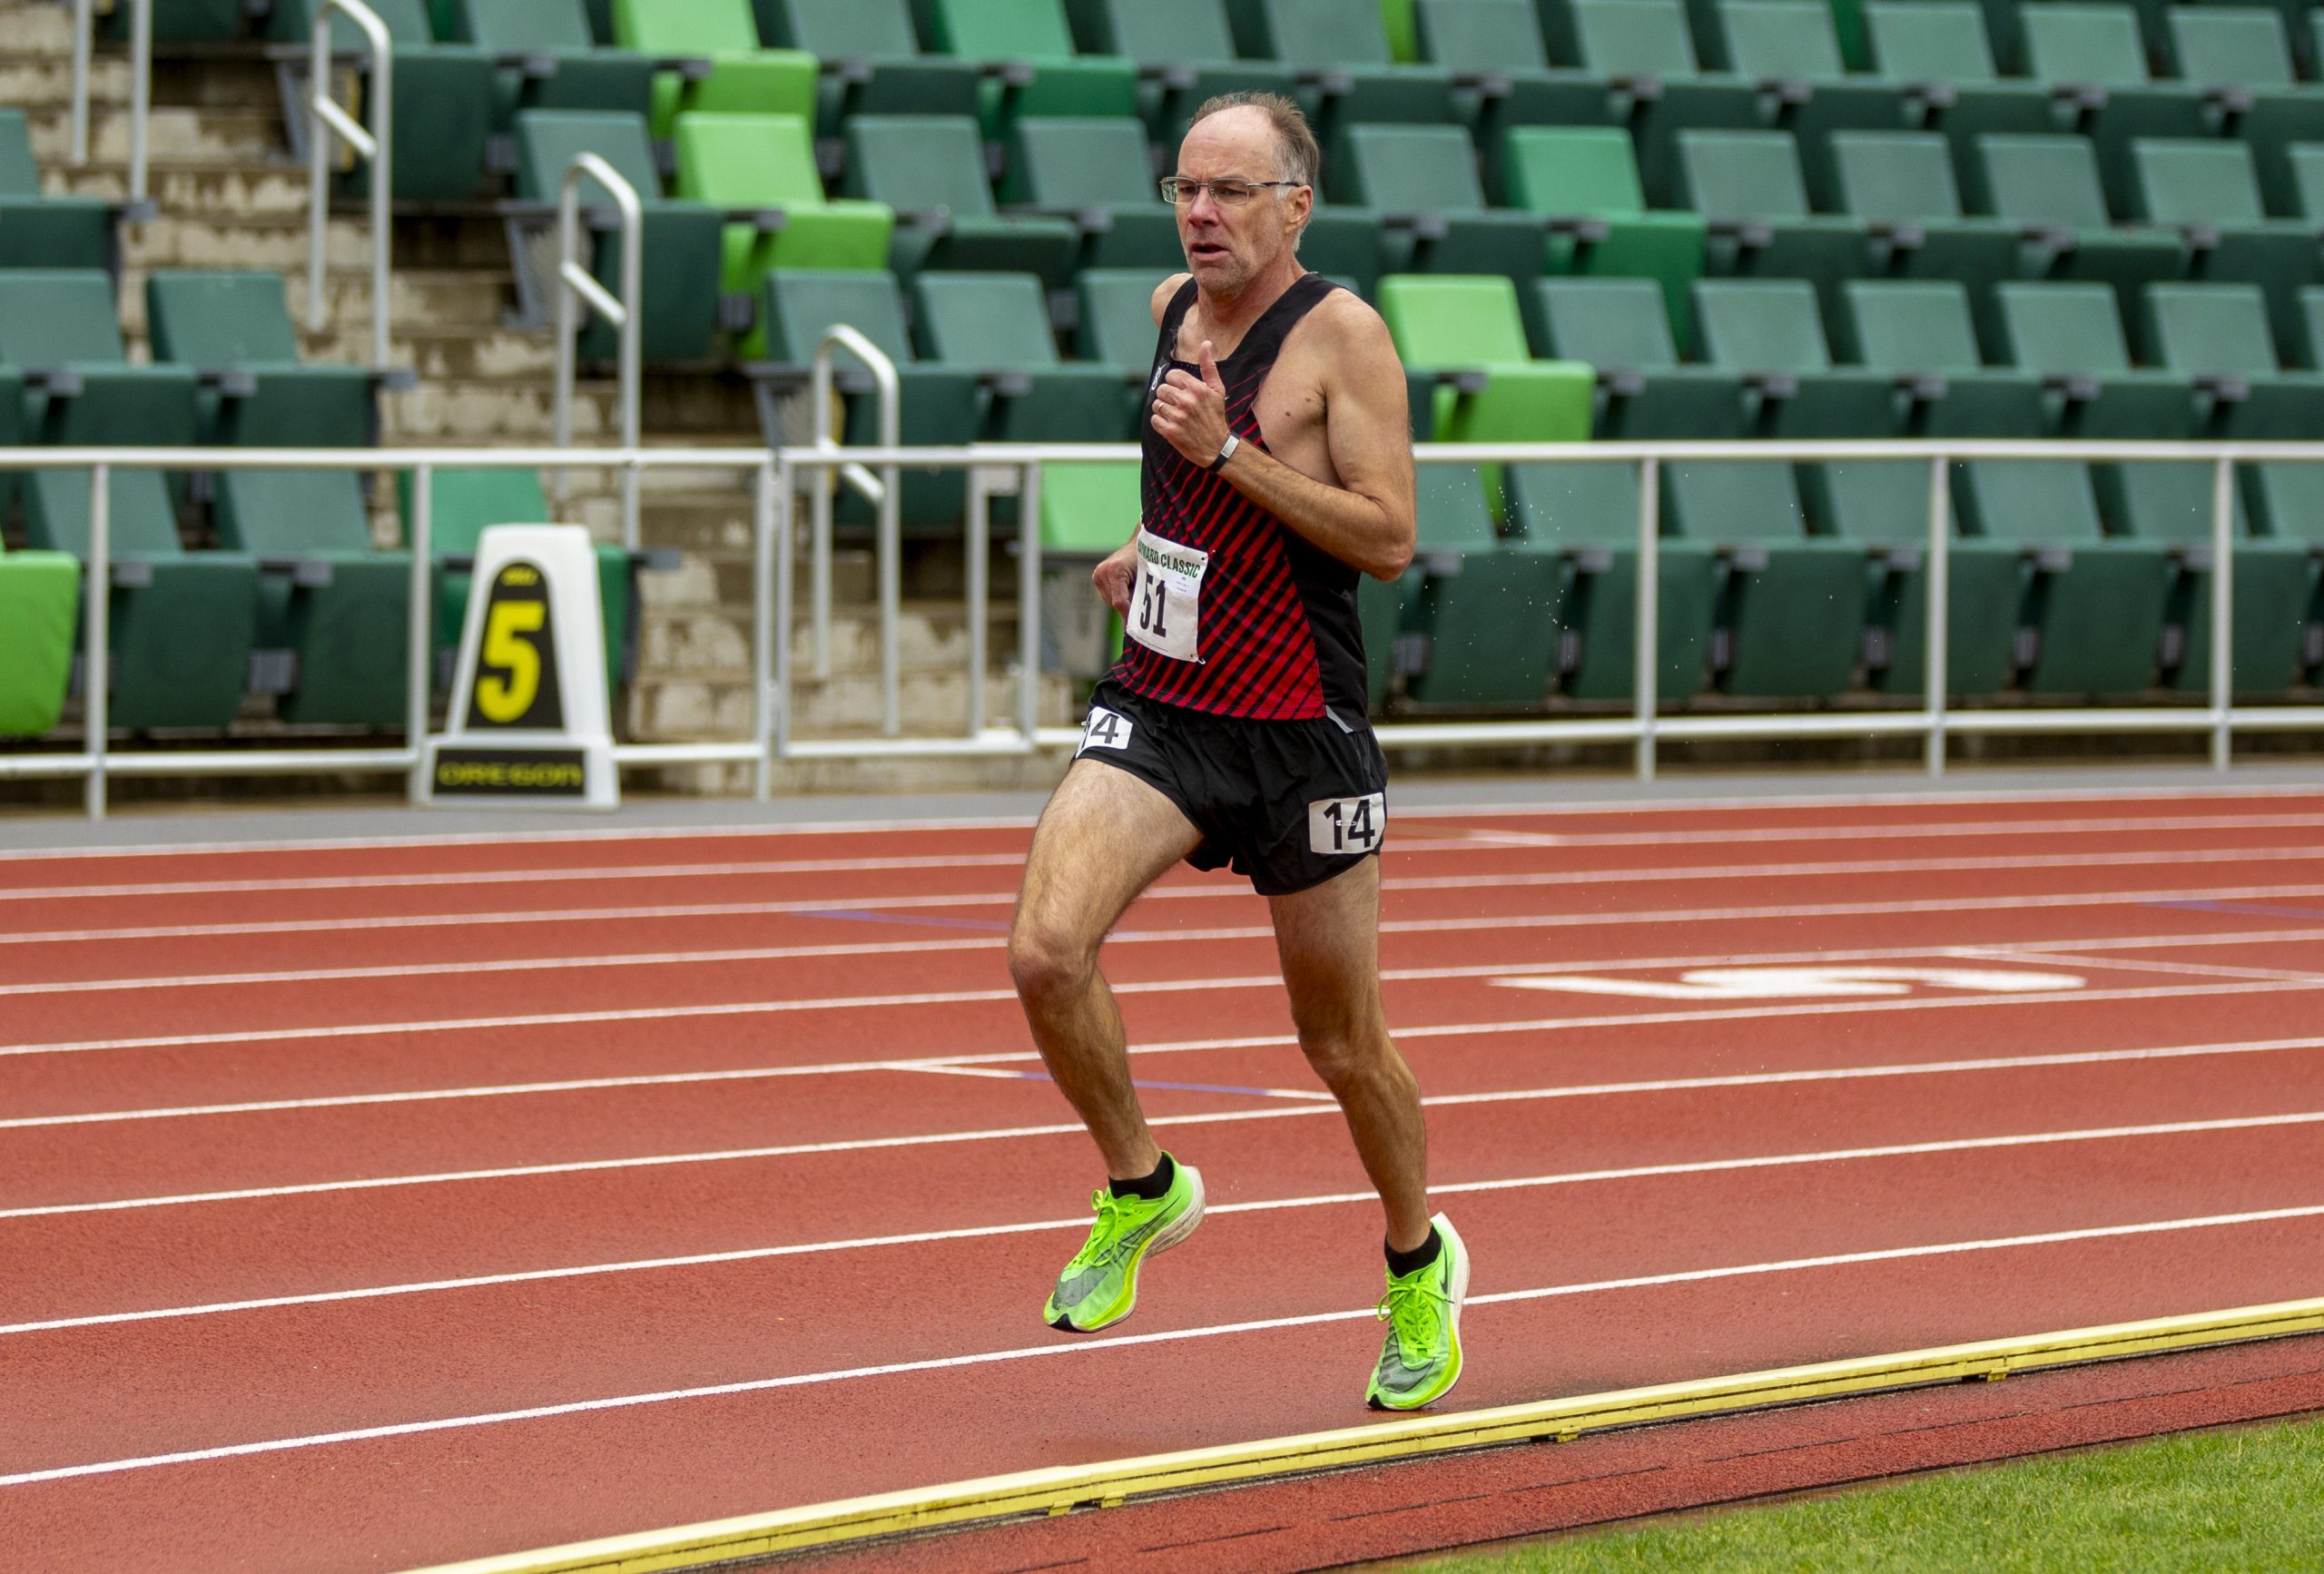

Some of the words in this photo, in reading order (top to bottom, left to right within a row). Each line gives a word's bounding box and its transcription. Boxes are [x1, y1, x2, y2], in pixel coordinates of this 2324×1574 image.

[1161, 554, 1201, 579] CLASSIC
[1140, 571, 1167, 638] 51
[476, 600, 546, 723] 5
[437, 762, 583, 787] OREGON
[1323, 799, 1376, 851] 14
